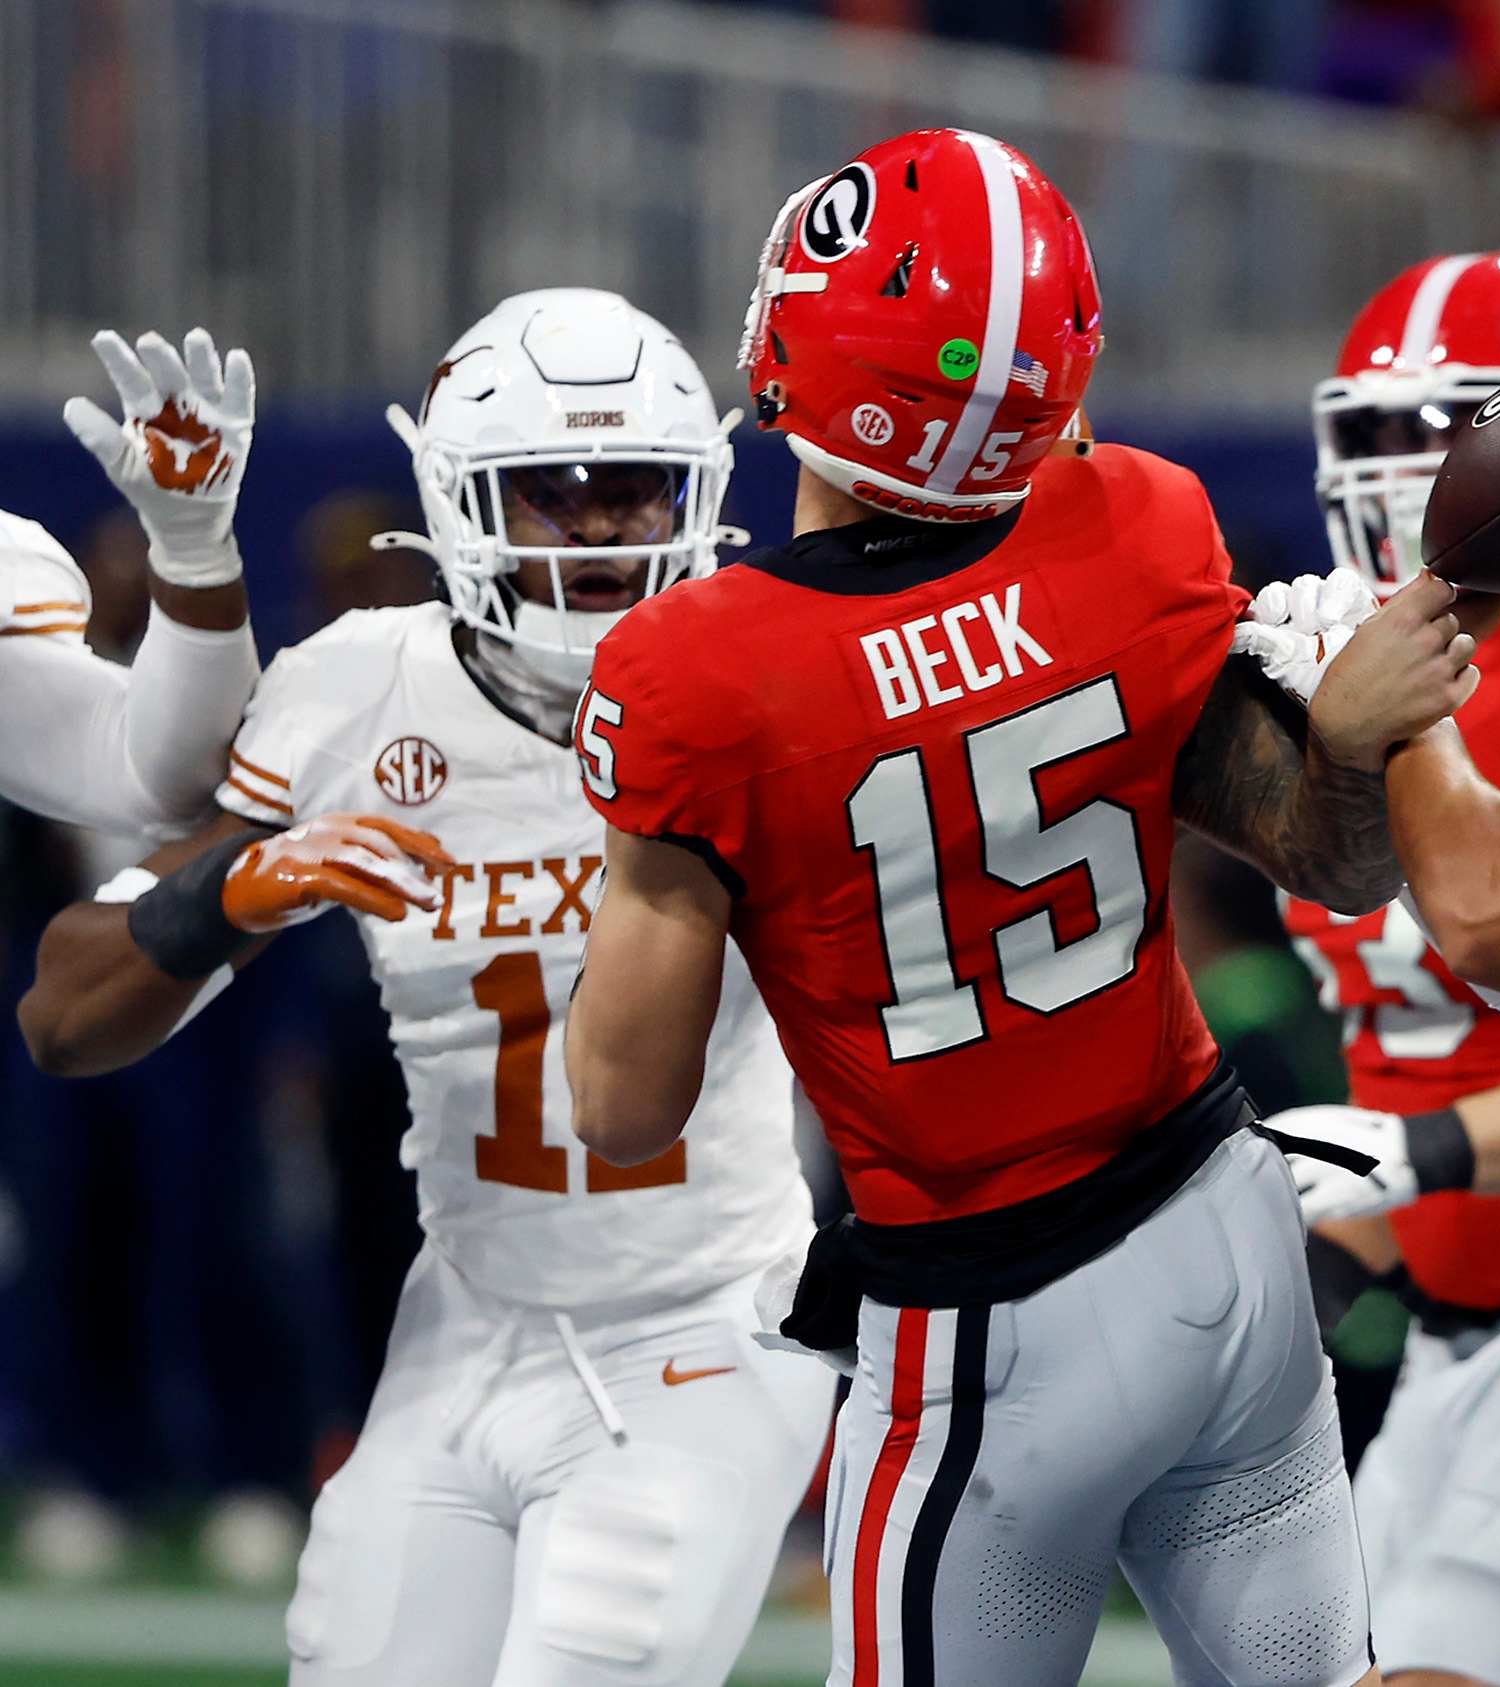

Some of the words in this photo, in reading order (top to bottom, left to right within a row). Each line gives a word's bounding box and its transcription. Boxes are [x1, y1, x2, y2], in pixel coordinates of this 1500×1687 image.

[807, 172, 872, 255] G
[943, 349, 976, 367] C2P
[566, 411, 624, 428] HORNS
[856, 406, 891, 443] SEC
[859, 582, 1053, 721] BECK
[375, 736, 447, 806] SEC
[425, 855, 603, 940] TEX
[845, 672, 1150, 1066] 15
[471, 951, 687, 1194] 1
